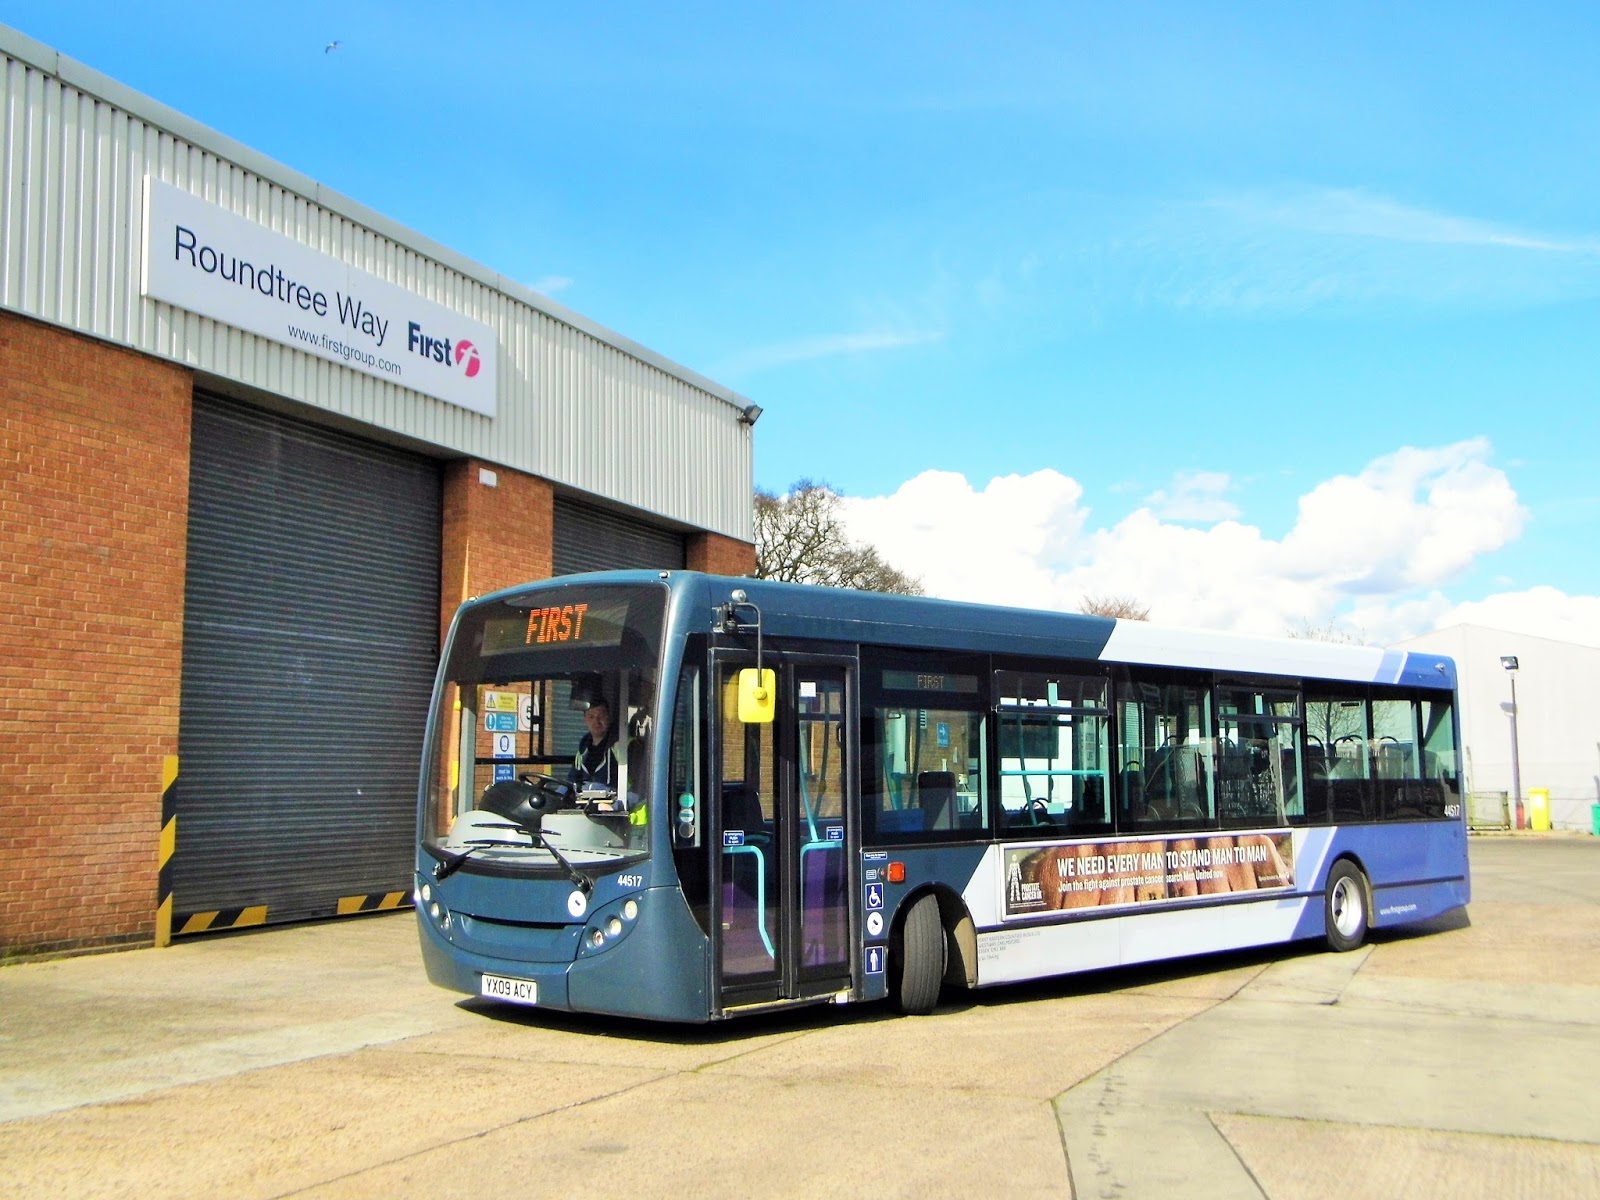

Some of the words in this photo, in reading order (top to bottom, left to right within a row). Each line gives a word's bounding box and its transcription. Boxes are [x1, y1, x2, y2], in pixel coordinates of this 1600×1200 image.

[175, 225, 328, 316] Roundtree
[336, 291, 389, 347] Way
[287, 324, 402, 376] www.firstgroup.com
[407, 320, 452, 367] First
[525, 603, 588, 644] FIRST
[917, 674, 945, 689] FIRST
[1444, 804, 1460, 817] 44517
[1057, 858, 1075, 877] WE
[1077, 856, 1105, 876] NEED
[1107, 853, 1140, 874] EVERY
[1142, 852, 1164, 871] MAN
[1166, 851, 1178, 869] TO
[1181, 849, 1211, 868] STAND
[1212, 847, 1233, 865] MAN
[1234, 846, 1245, 863] TO
[1247, 845, 1267, 862] MAN
[617, 874, 643, 888] 44517
[1058, 882, 1072, 892] Join
[1073, 881, 1083, 891] the
[1084, 880, 1098, 892] fight
[1099, 878, 1120, 890] against
[1121, 876, 1144, 889] prostate
[486, 977, 511, 997] YX09
[514, 981, 533, 999] ACY
